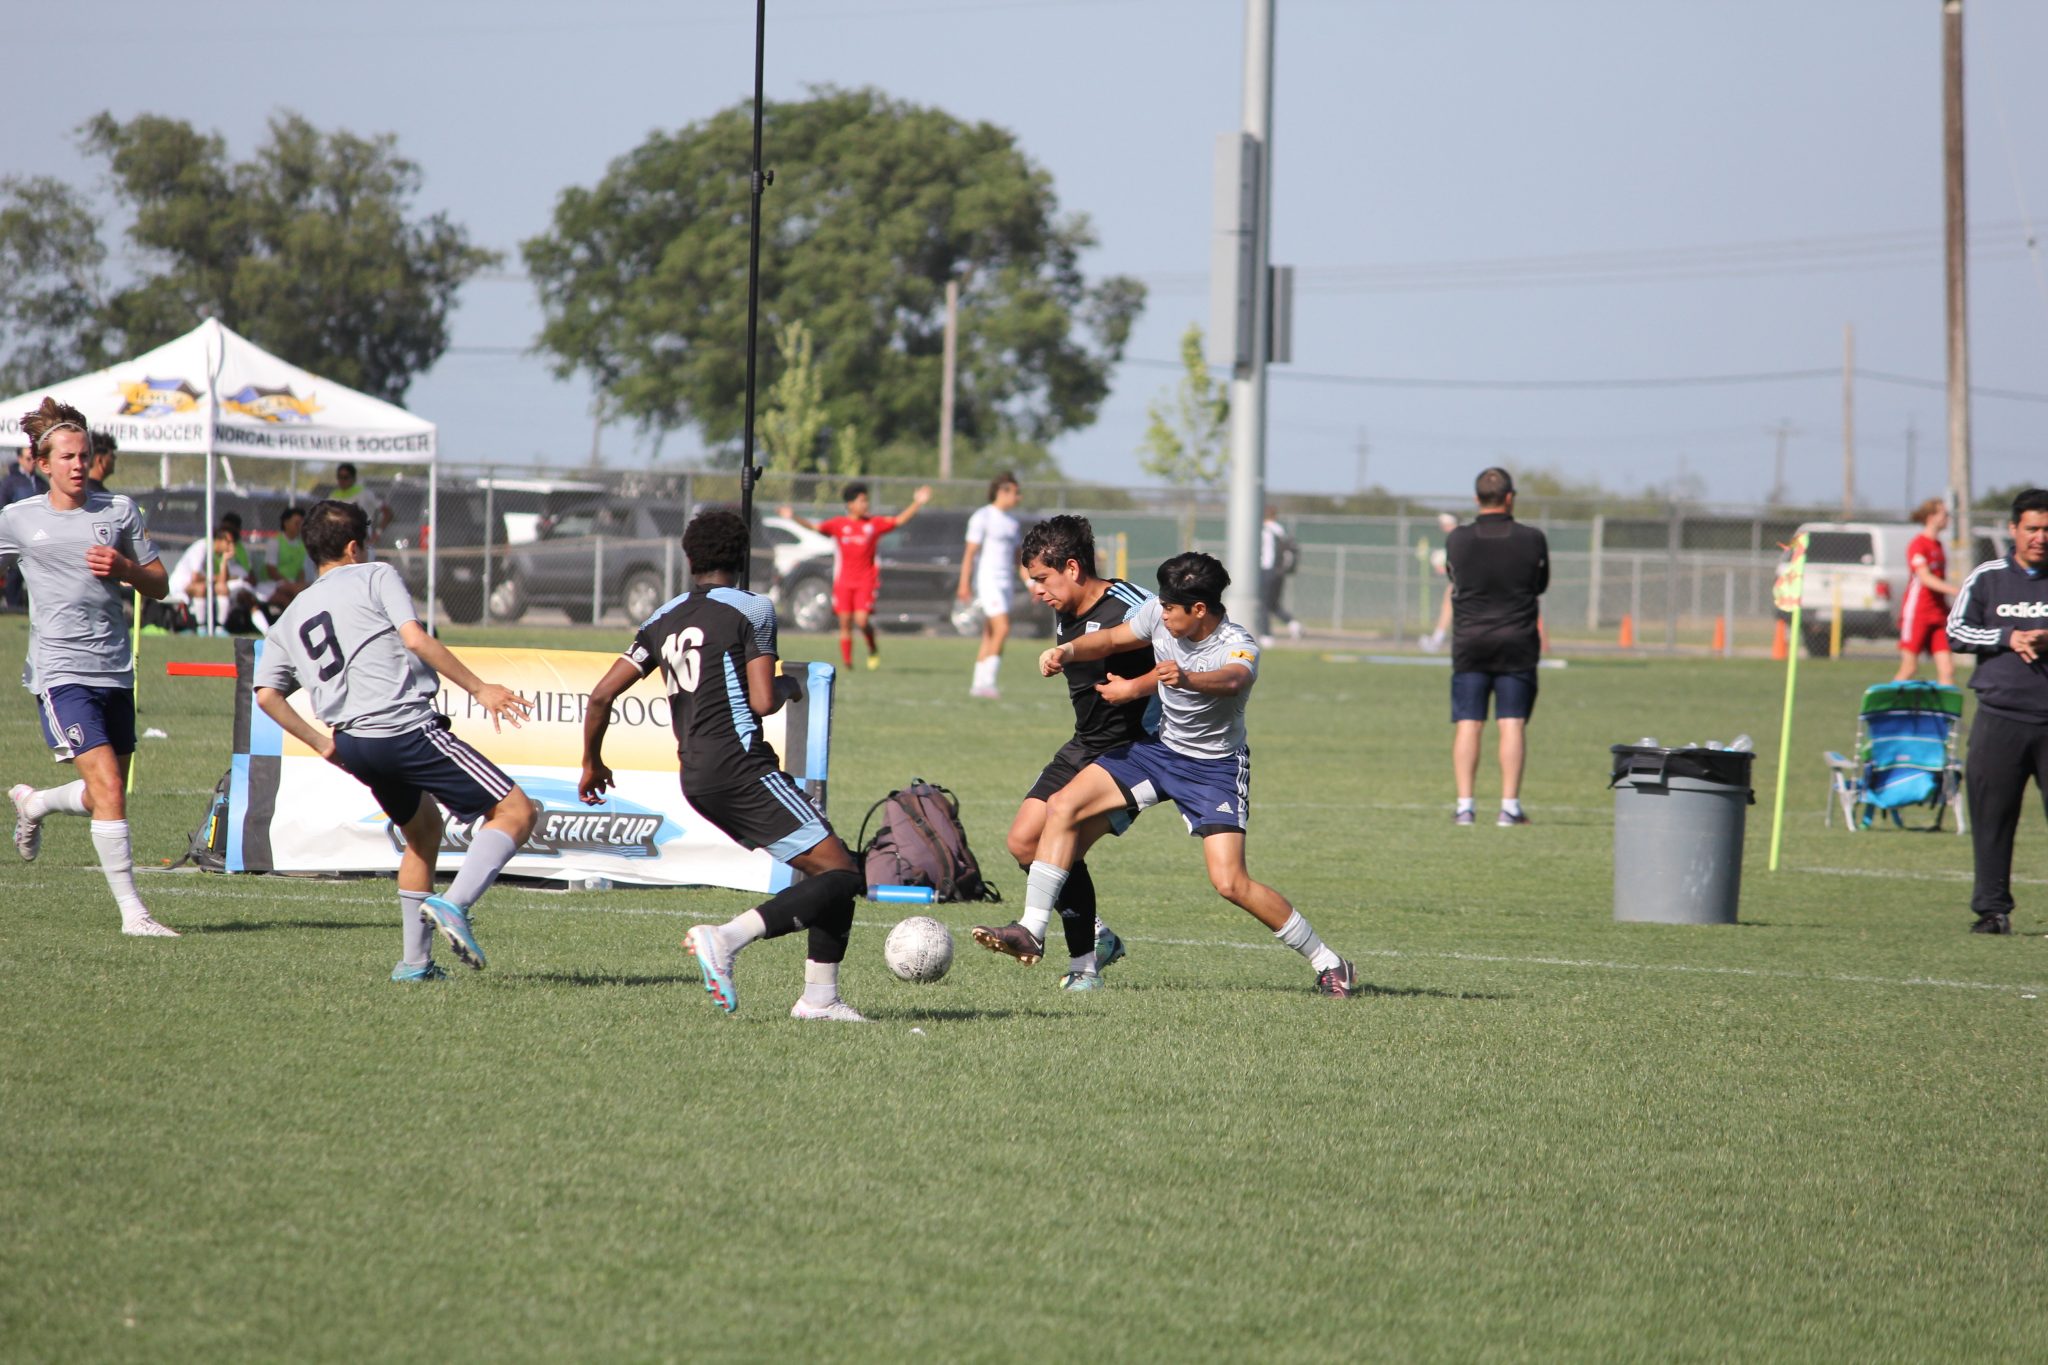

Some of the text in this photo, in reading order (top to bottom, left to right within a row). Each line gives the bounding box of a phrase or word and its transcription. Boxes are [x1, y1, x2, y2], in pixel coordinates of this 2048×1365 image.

[143, 424, 203, 441] SOCCER
[215, 425, 429, 451] NORCAL PREMIER SOCCER
[299, 610, 345, 682] 9
[661, 626, 704, 697] 16
[542, 814, 611, 843] STATE
[608, 817, 658, 845] CUP
